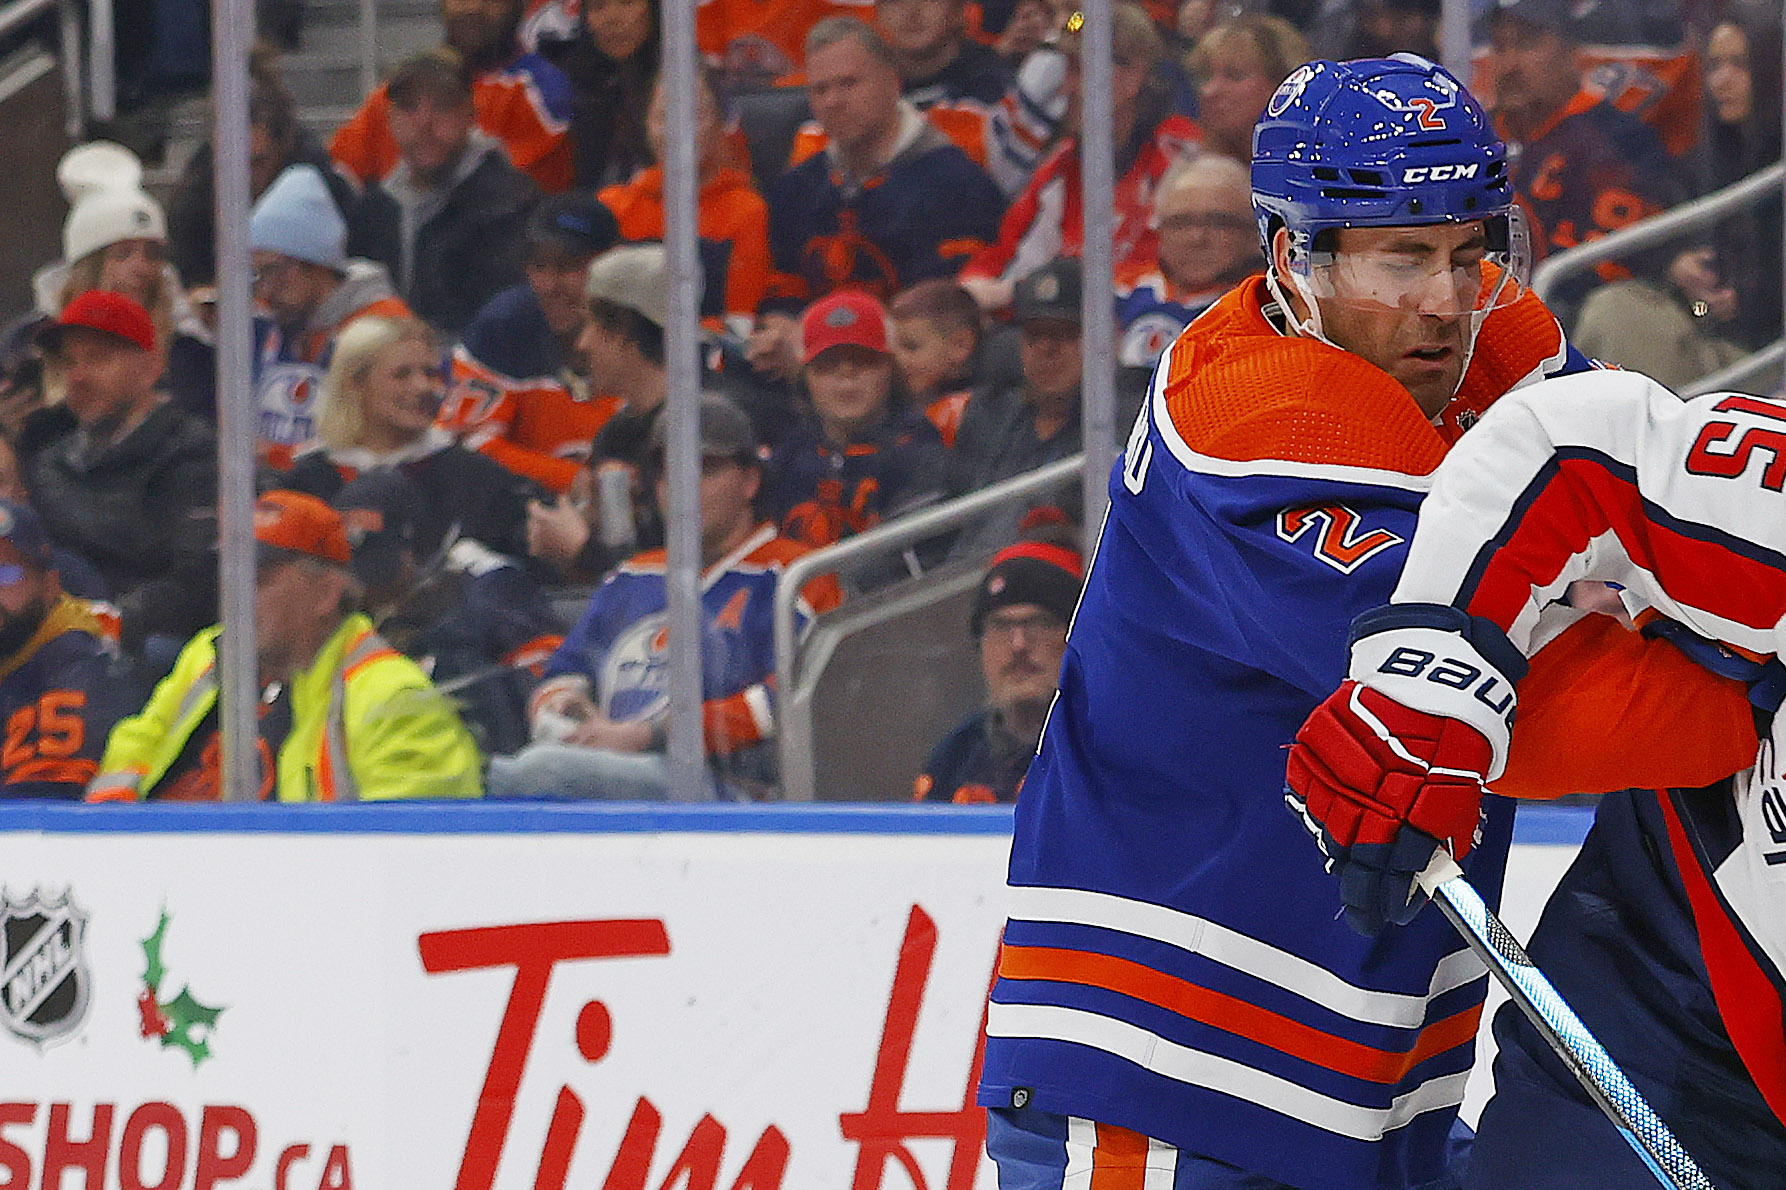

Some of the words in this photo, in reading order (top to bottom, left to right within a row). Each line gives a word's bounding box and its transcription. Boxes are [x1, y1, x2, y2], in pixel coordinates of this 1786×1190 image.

[1408, 98, 1447, 132] 2
[1403, 163, 1479, 185] CCM
[1276, 503, 1405, 575] 2
[1377, 646, 1517, 722] BAU
